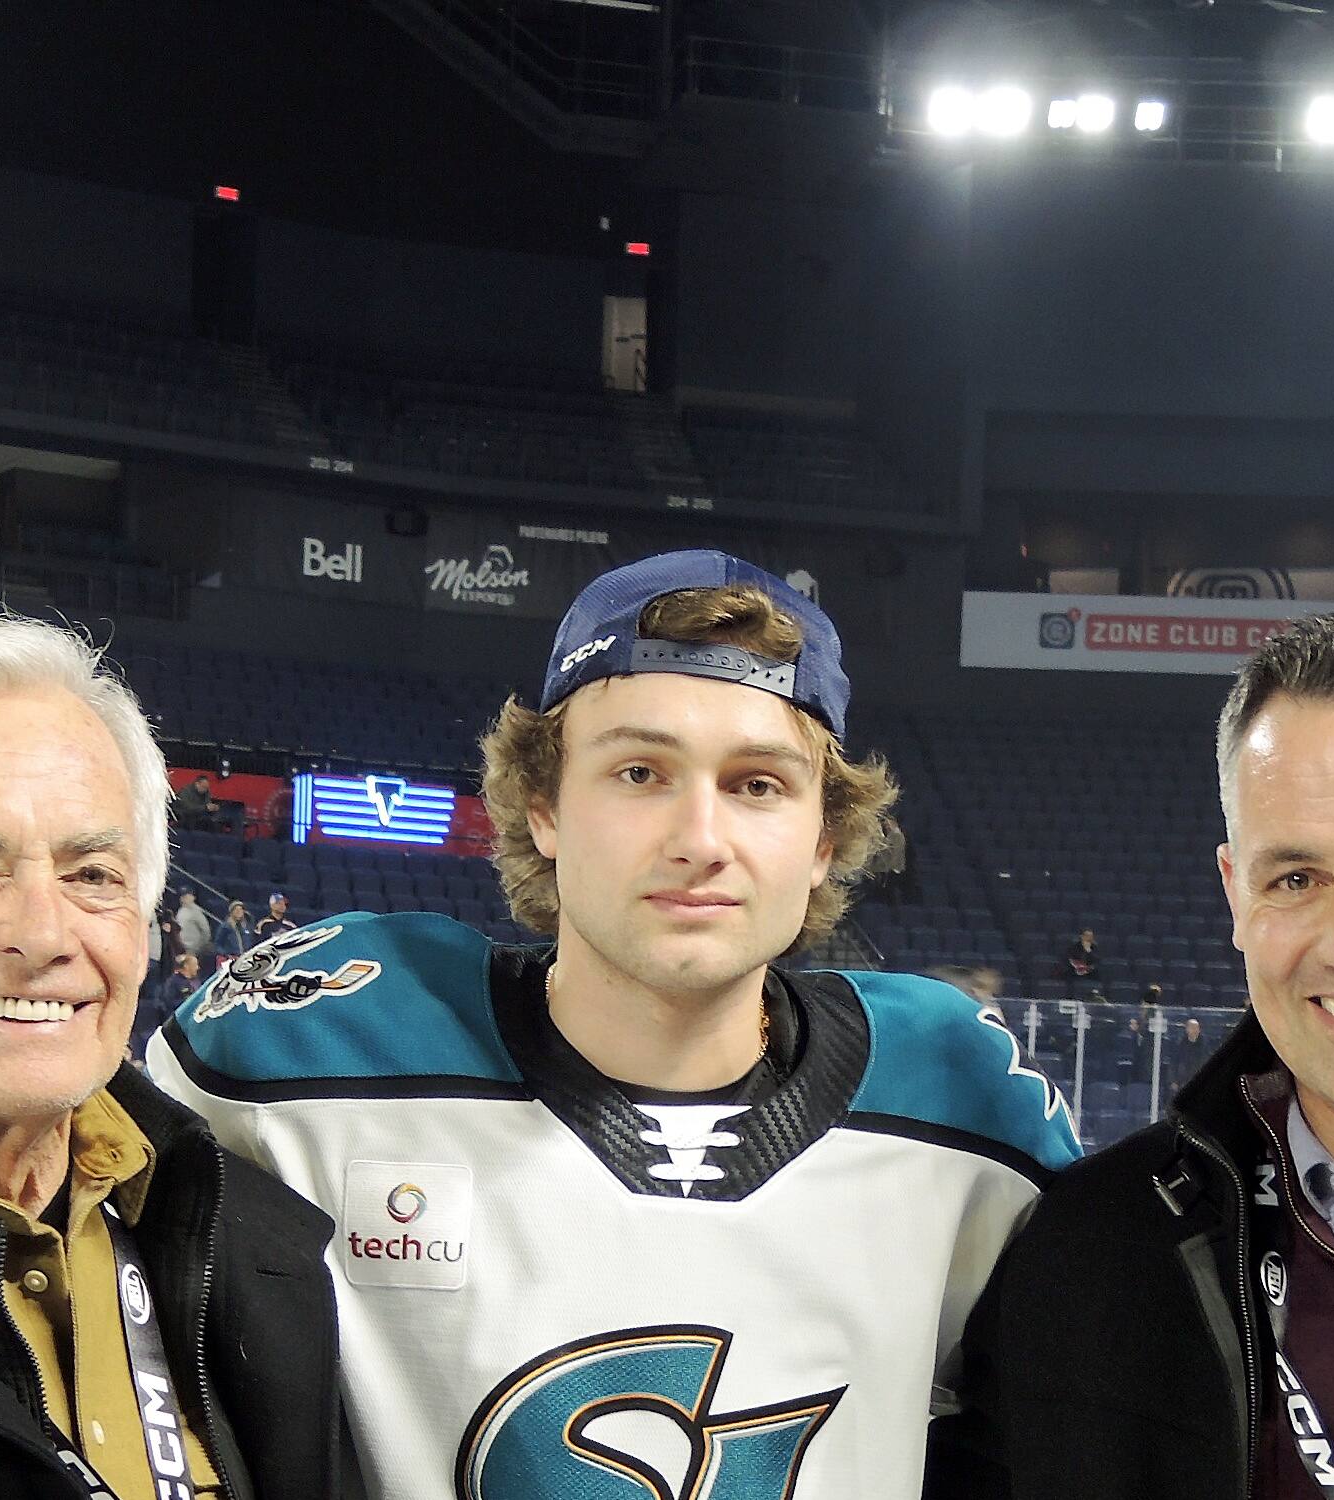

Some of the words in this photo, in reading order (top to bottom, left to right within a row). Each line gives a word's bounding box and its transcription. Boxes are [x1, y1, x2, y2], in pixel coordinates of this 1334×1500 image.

[303, 537, 363, 583] Bell
[425, 558, 529, 600] Molson
[560, 635, 617, 672] CCM
[1091, 622, 1161, 644] ZONE
[1169, 624, 1238, 646] CLUB
